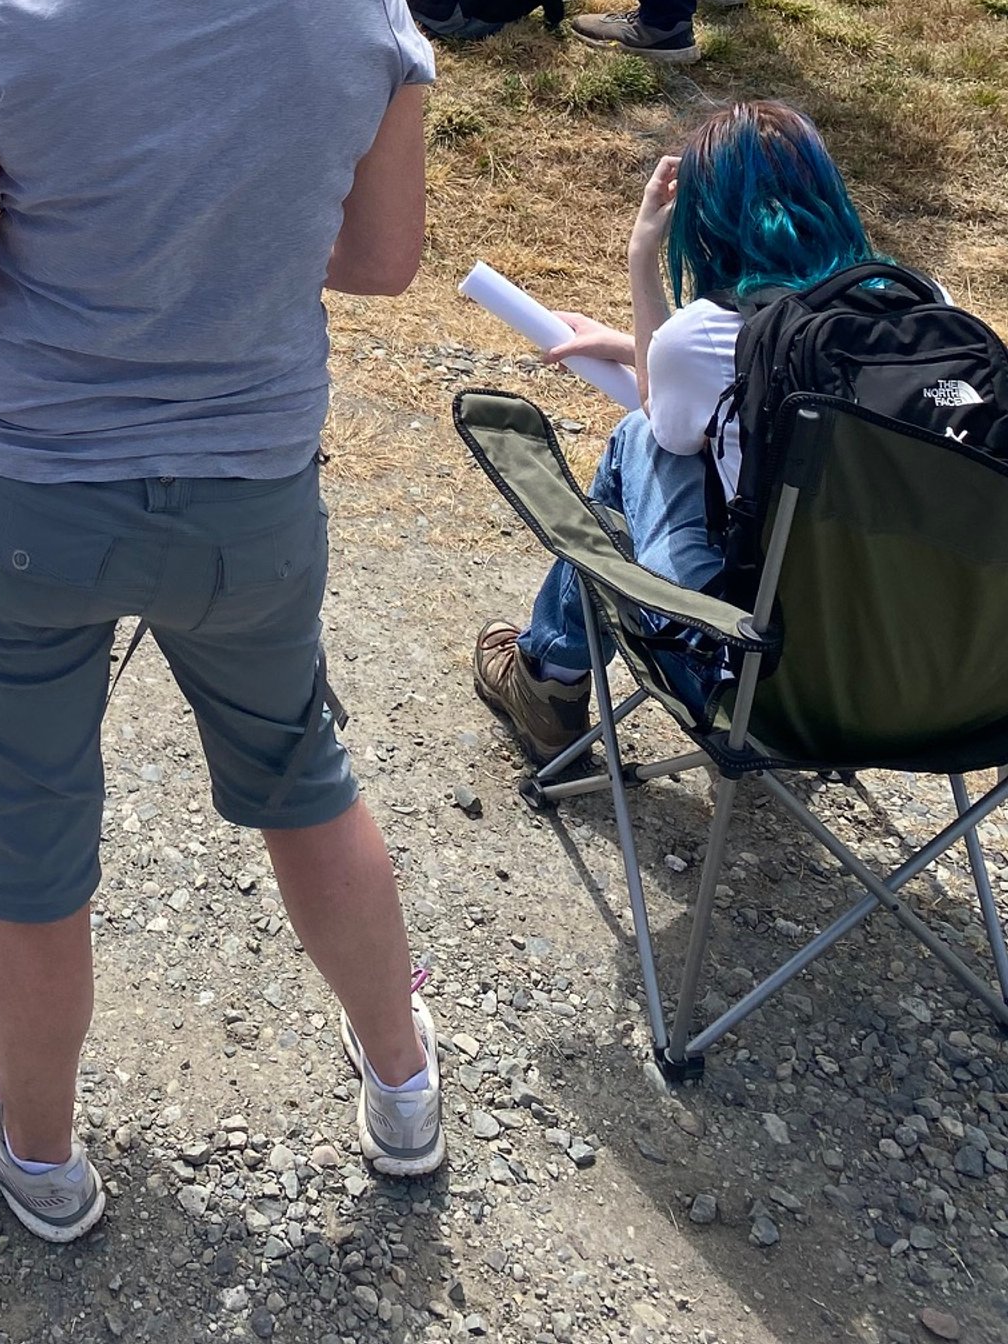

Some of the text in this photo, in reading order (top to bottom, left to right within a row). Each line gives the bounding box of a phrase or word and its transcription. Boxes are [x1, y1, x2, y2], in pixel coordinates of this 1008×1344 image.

[937, 379, 958, 389] THE
[923, 387, 960, 398] NORTH
[935, 397, 963, 407] FACE
